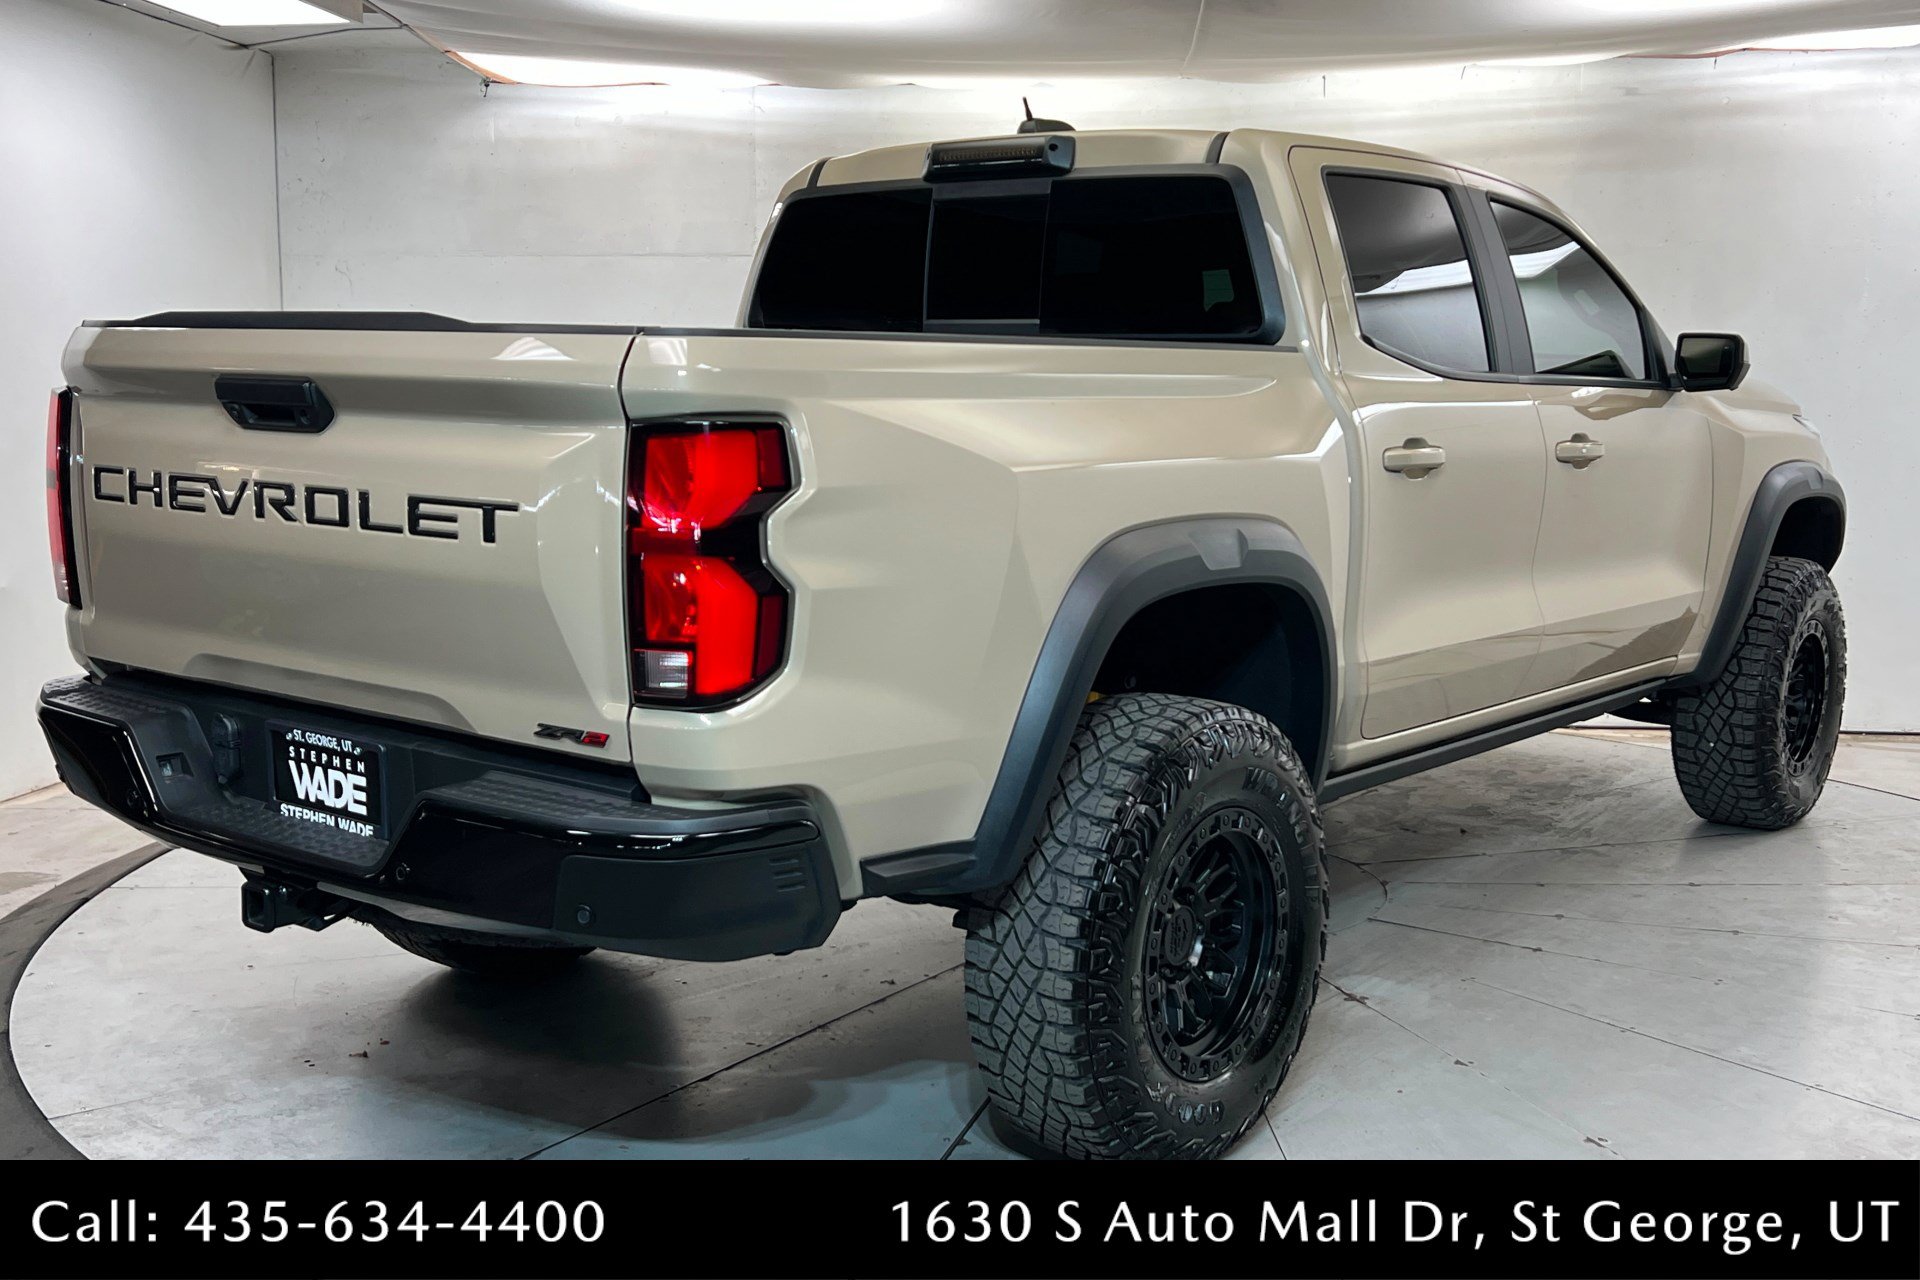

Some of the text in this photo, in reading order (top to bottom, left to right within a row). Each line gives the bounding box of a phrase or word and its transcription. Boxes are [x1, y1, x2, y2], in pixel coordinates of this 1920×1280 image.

[92, 465, 521, 544] CHEVROLET
[293, 729, 353, 752] ST. GEORGE, UT
[533, 723, 610, 748] ZR2
[288, 746, 365, 773] STEPHEN
[288, 760, 368, 816] WADE
[280, 803, 374, 837] STEPHEN WADE
